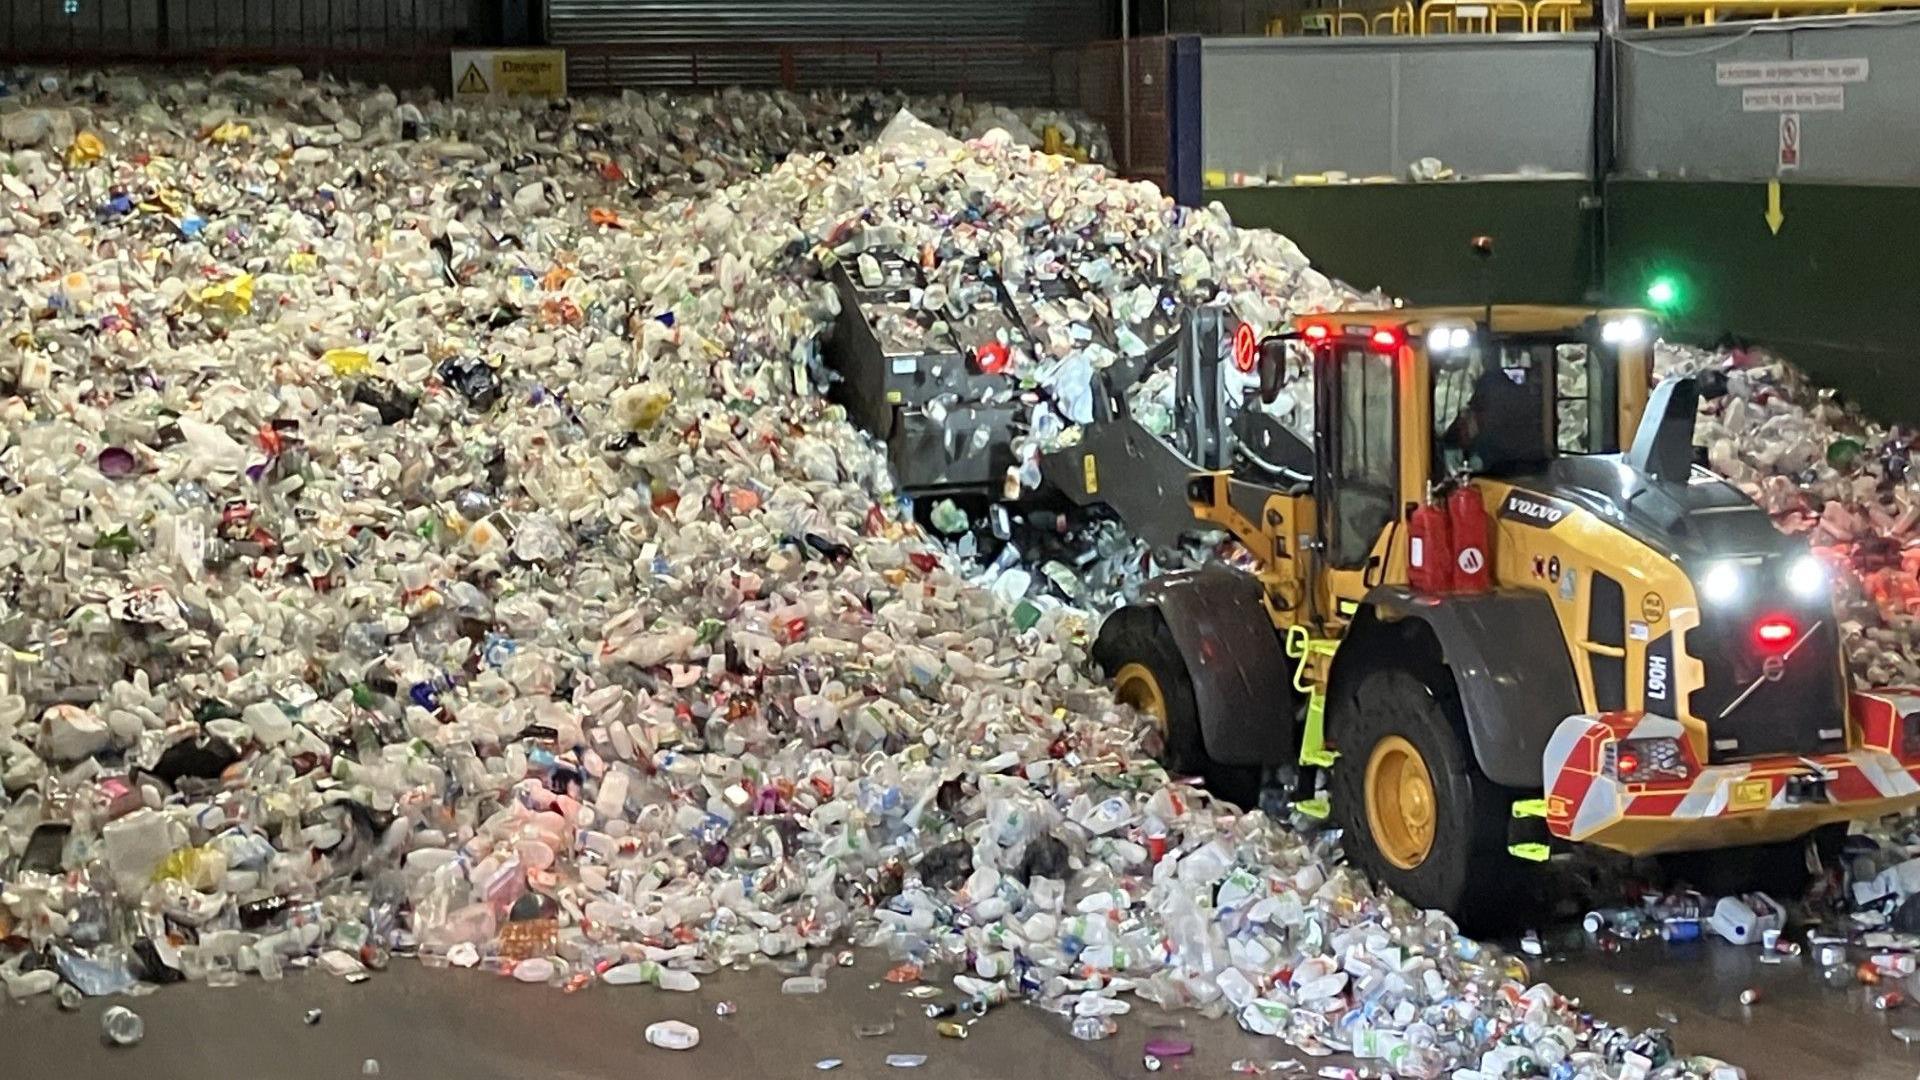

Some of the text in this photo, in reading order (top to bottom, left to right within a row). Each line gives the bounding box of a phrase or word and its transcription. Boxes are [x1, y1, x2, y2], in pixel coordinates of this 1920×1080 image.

[502, 60, 552, 74] Danger
[1509, 497, 1562, 522] VOLVO
[1648, 656, 1667, 700] L90H
